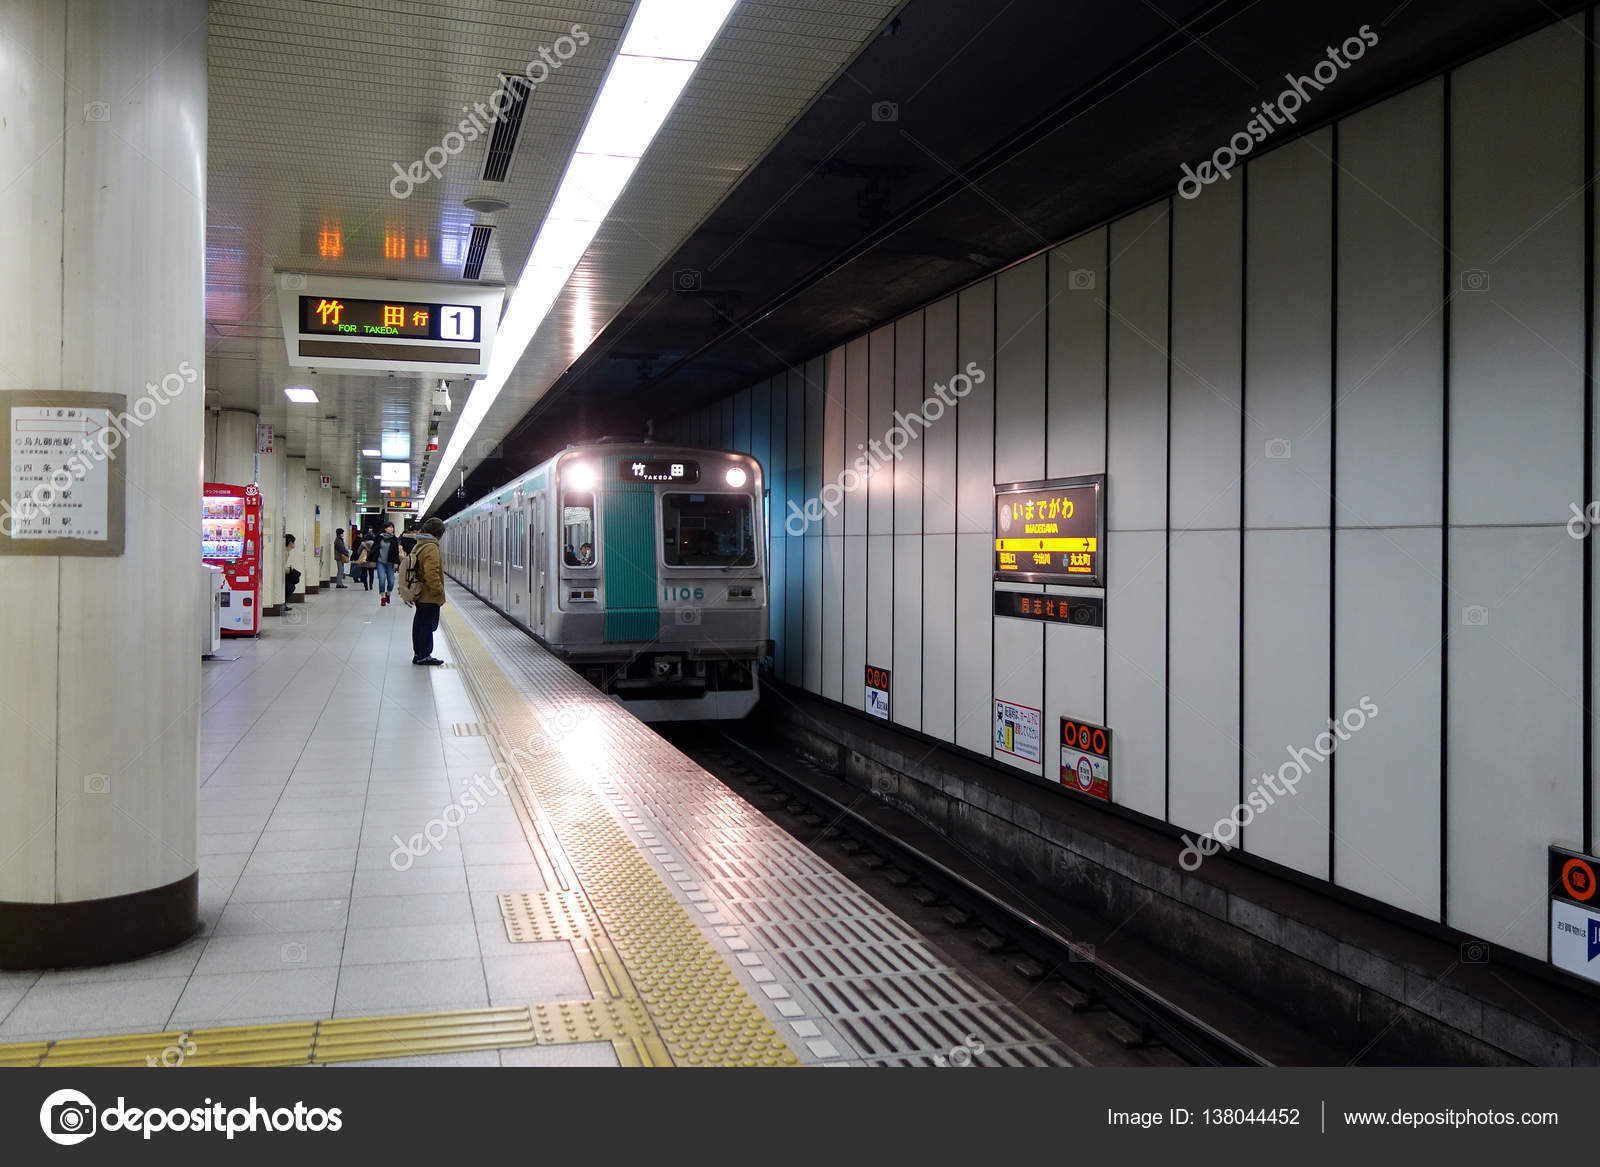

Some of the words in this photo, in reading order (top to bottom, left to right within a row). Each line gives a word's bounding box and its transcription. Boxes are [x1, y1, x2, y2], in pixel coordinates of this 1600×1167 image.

[338, 324, 357, 333] FOR
[364, 325, 399, 335] TAKEDA
[450, 312, 461, 335] 1
[632, 462, 684, 477] 竹田
[1013, 497, 1074, 520] いまでがわ
[1033, 552, 1051, 565] 今出川
[1070, 553, 1091, 566] 丸太町
[664, 587, 705, 600] 1106
